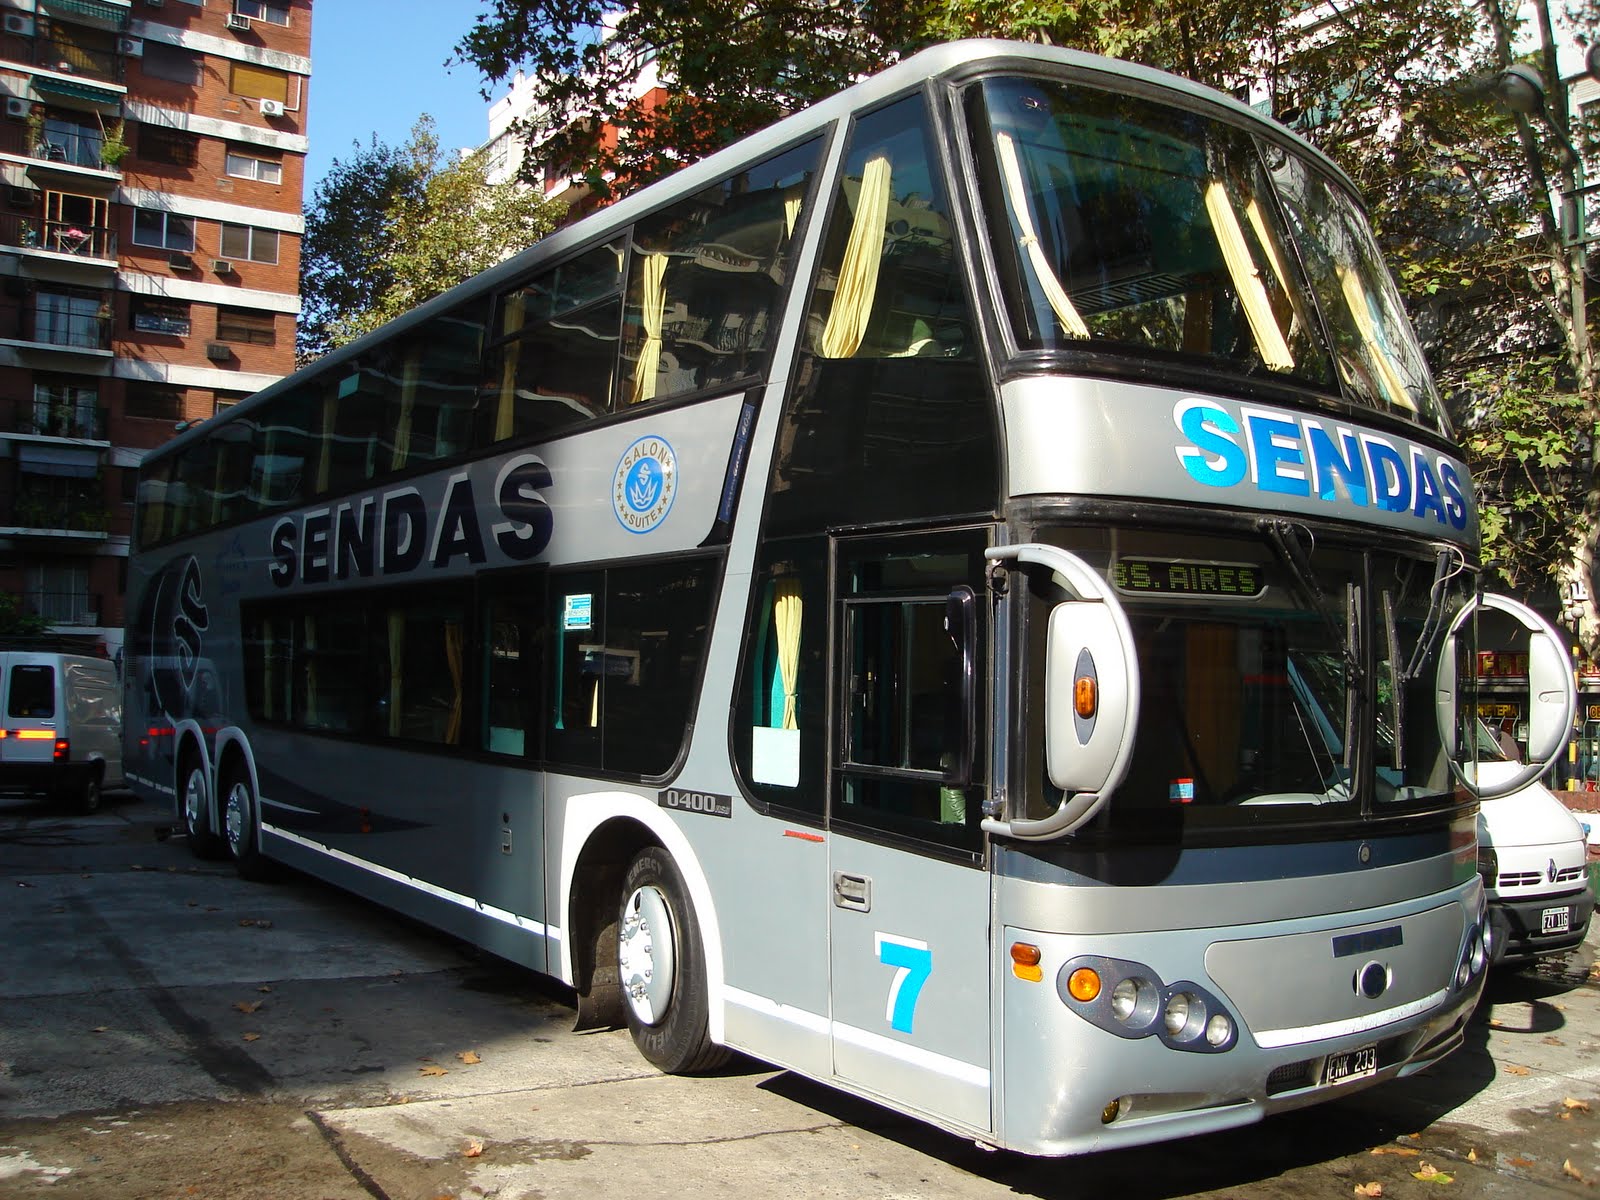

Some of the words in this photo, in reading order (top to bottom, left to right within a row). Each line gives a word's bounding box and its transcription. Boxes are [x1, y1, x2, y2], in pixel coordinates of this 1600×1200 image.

[624, 442, 668, 470] SALON
[1172, 397, 1467, 531] SENDAS
[269, 454, 554, 588] SENDAS
[628, 509, 658, 528] SUITE
[1169, 566, 1255, 592] AIRES
[1557, 913, 1568, 927] 116
[875, 930, 932, 1035] 7
[1355, 1048, 1375, 1073] 233
